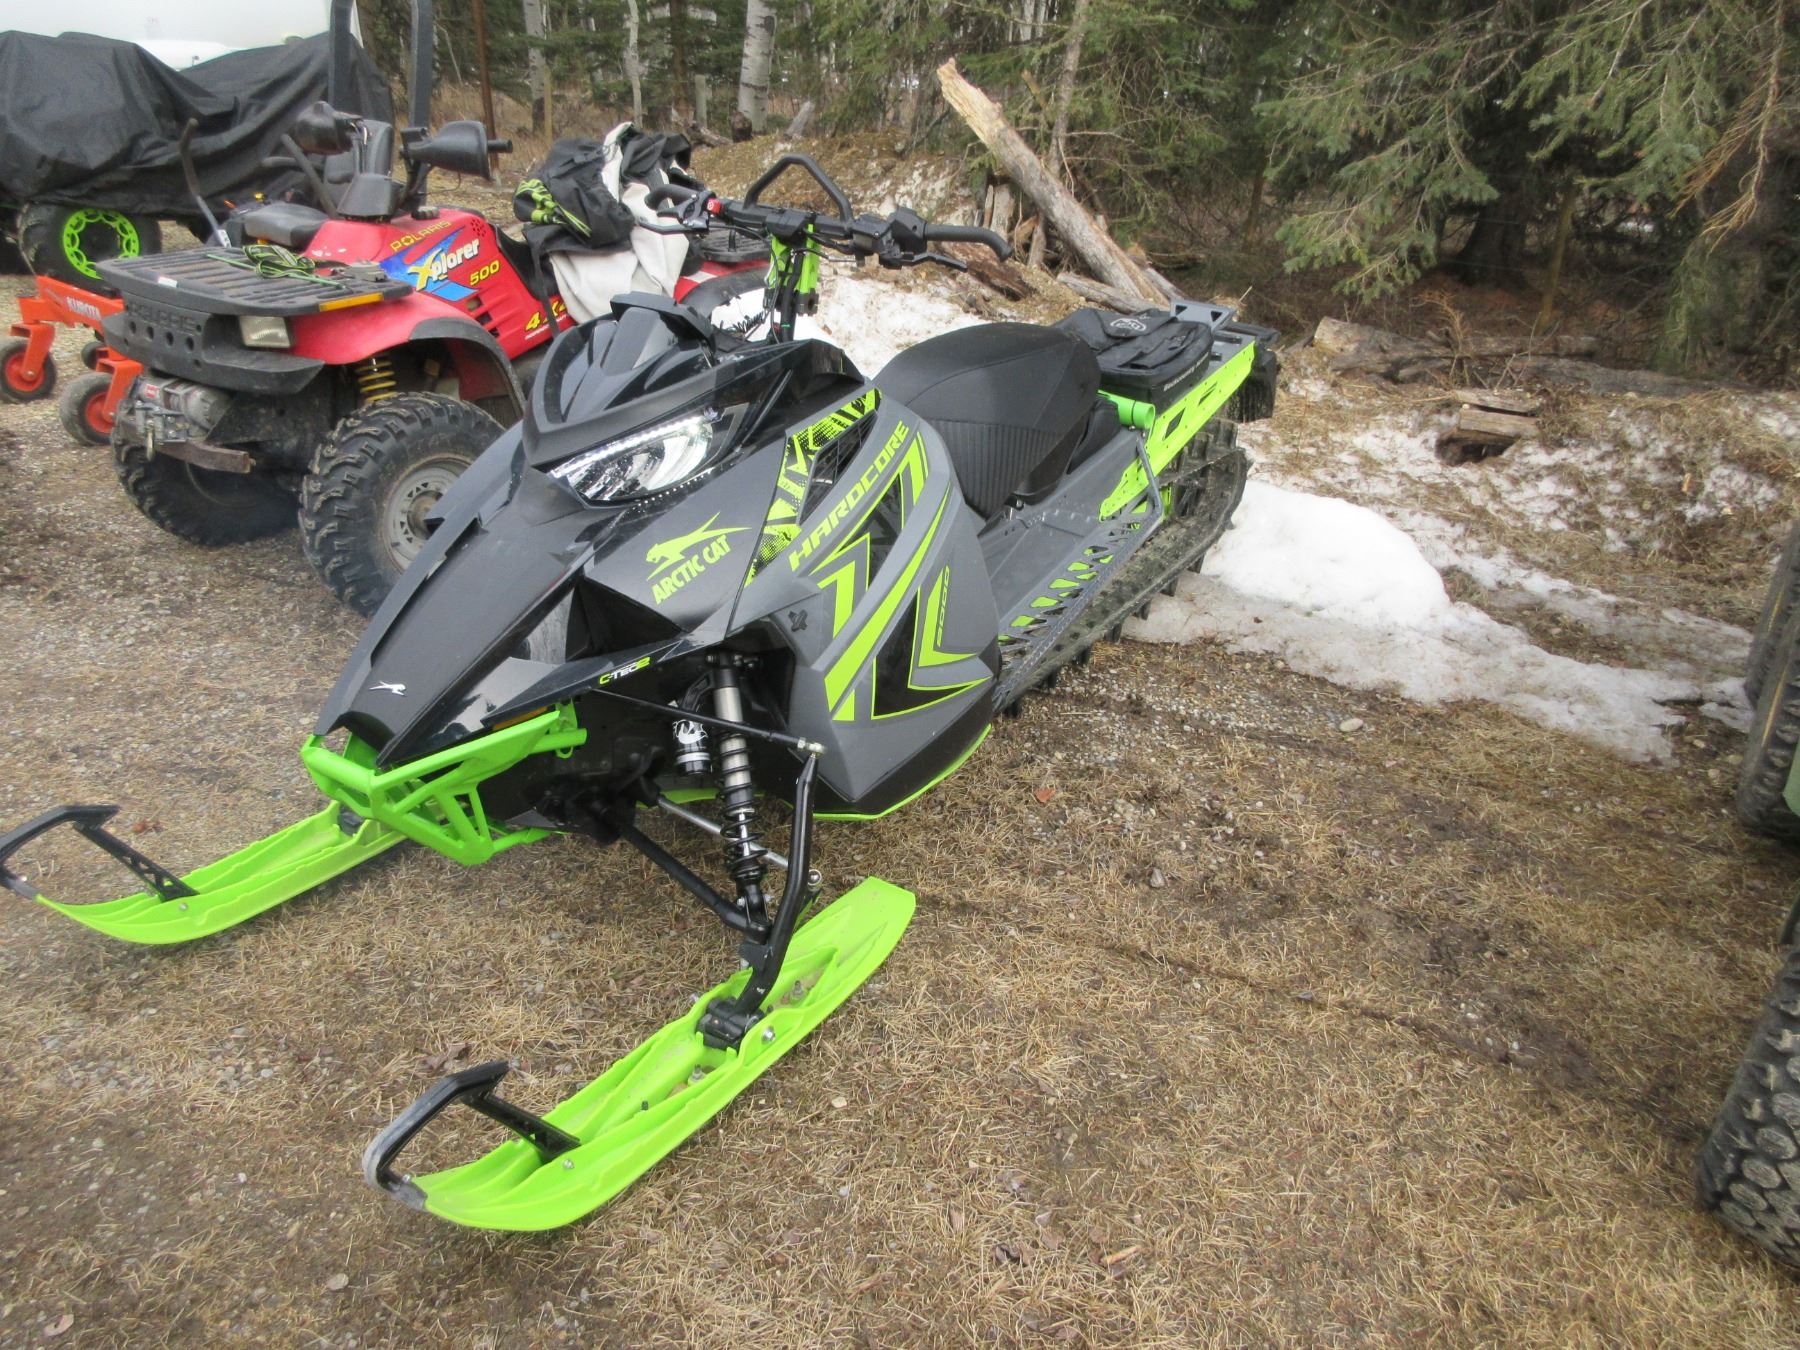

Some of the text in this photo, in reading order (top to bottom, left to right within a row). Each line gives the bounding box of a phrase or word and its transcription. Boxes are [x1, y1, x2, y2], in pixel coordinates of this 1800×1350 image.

[390, 221, 452, 252] POLARIS
[407, 238, 480, 292] Xplorer
[469, 259, 500, 286] 500
[788, 420, 910, 573] HARDCORE
[651, 534, 731, 605] ARCTIC CAT
